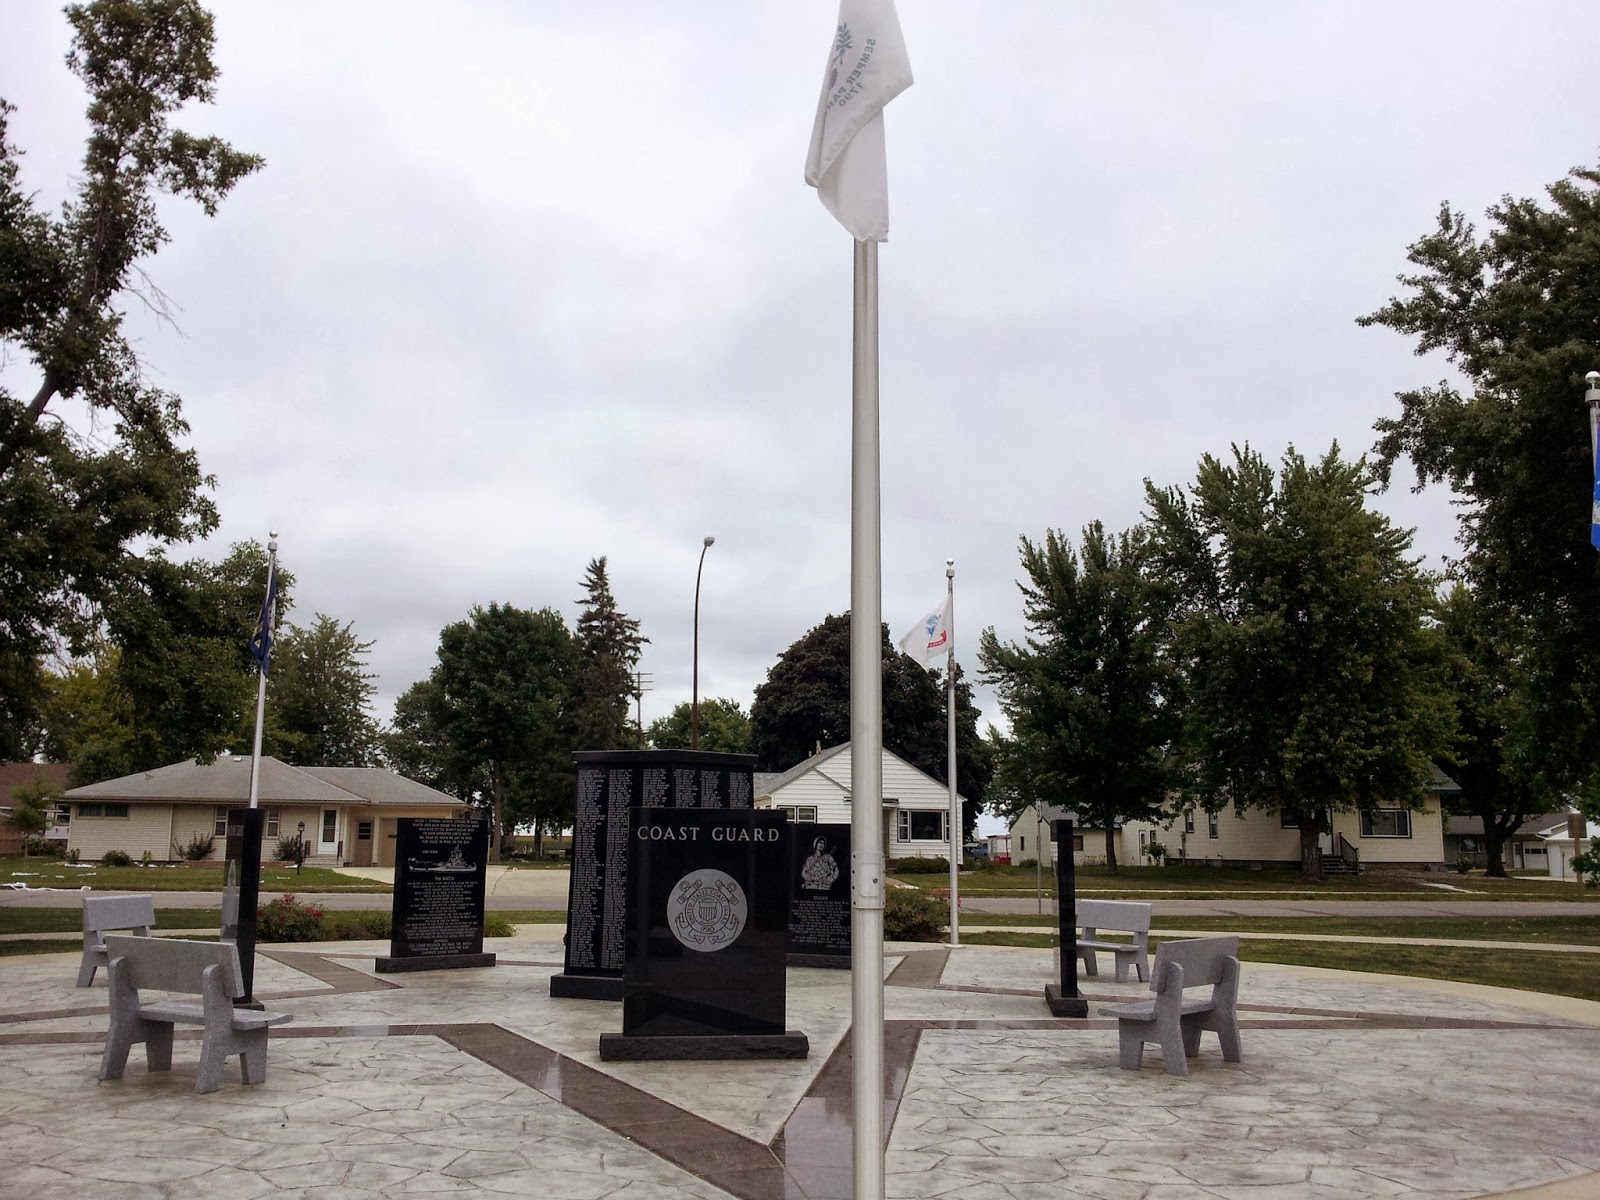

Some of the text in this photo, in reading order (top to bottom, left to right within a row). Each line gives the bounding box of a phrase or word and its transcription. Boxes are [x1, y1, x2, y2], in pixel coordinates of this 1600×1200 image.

[636, 825, 780, 842] COAST GUARD
[691, 889, 709, 902] STATES
[710, 889, 727, 903] COAST
